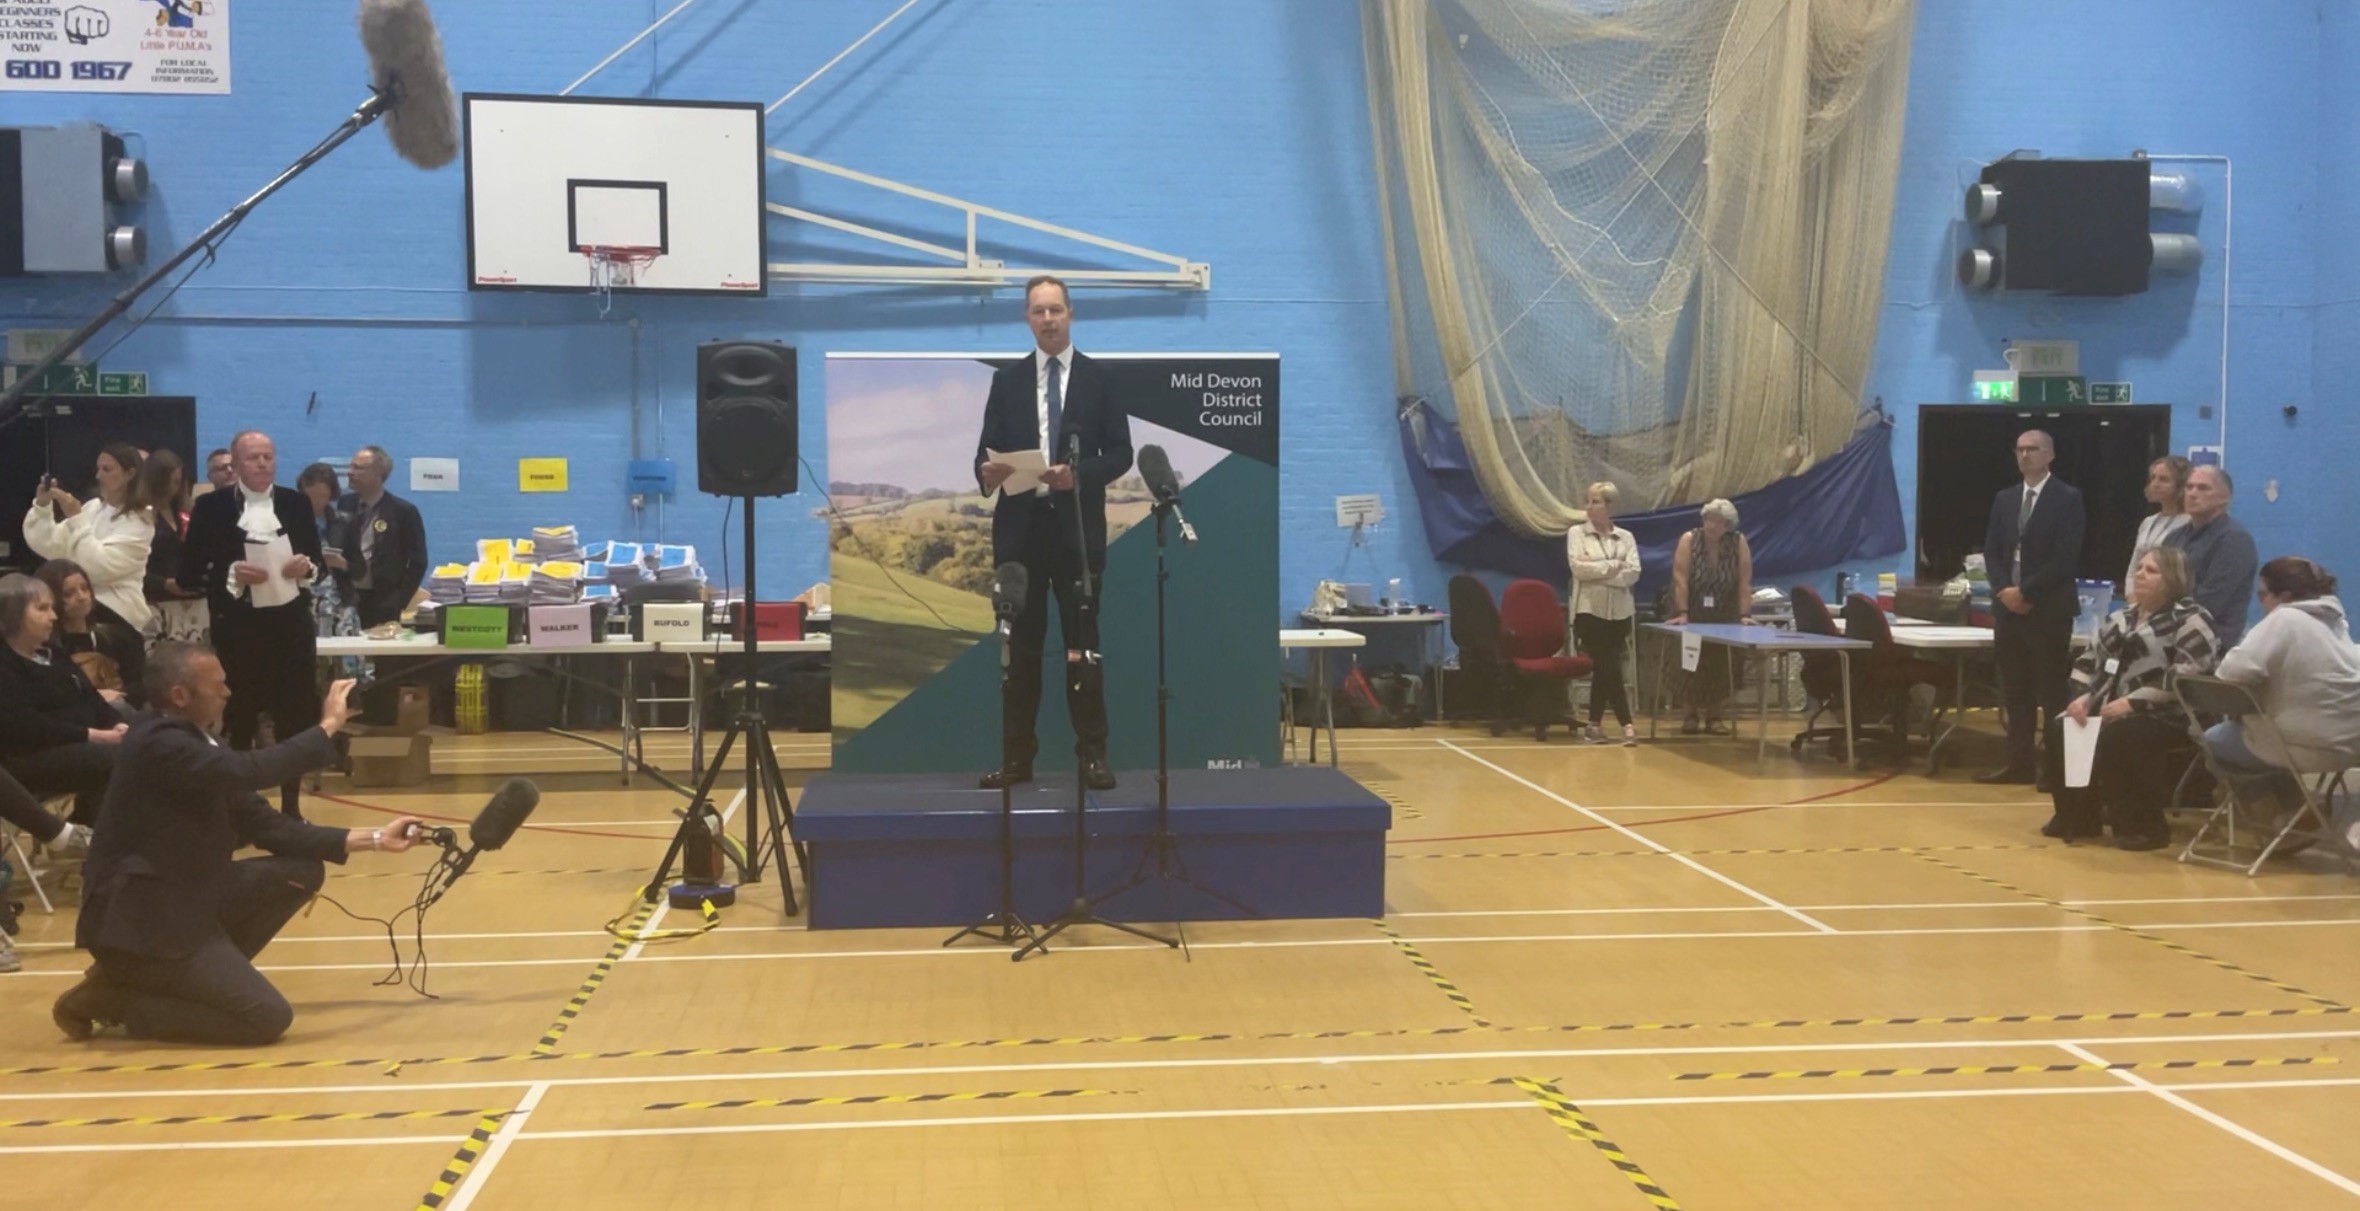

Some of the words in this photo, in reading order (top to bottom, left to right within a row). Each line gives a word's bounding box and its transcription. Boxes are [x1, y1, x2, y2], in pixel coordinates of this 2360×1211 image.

[0, 7, 61, 16] EGINNERS
[190, 29, 208, 38] Old
[12, 43, 41, 52] NOW
[5, 59, 62, 79] 600
[69, 61, 133, 80] 1967
[104, 376, 121, 384] Fire
[1170, 373, 1203, 388] Mid
[1207, 373, 1262, 388] Devon
[1203, 392, 1262, 407] District
[1199, 411, 1262, 426] Council
[540, 624, 579, 632] WALKER
